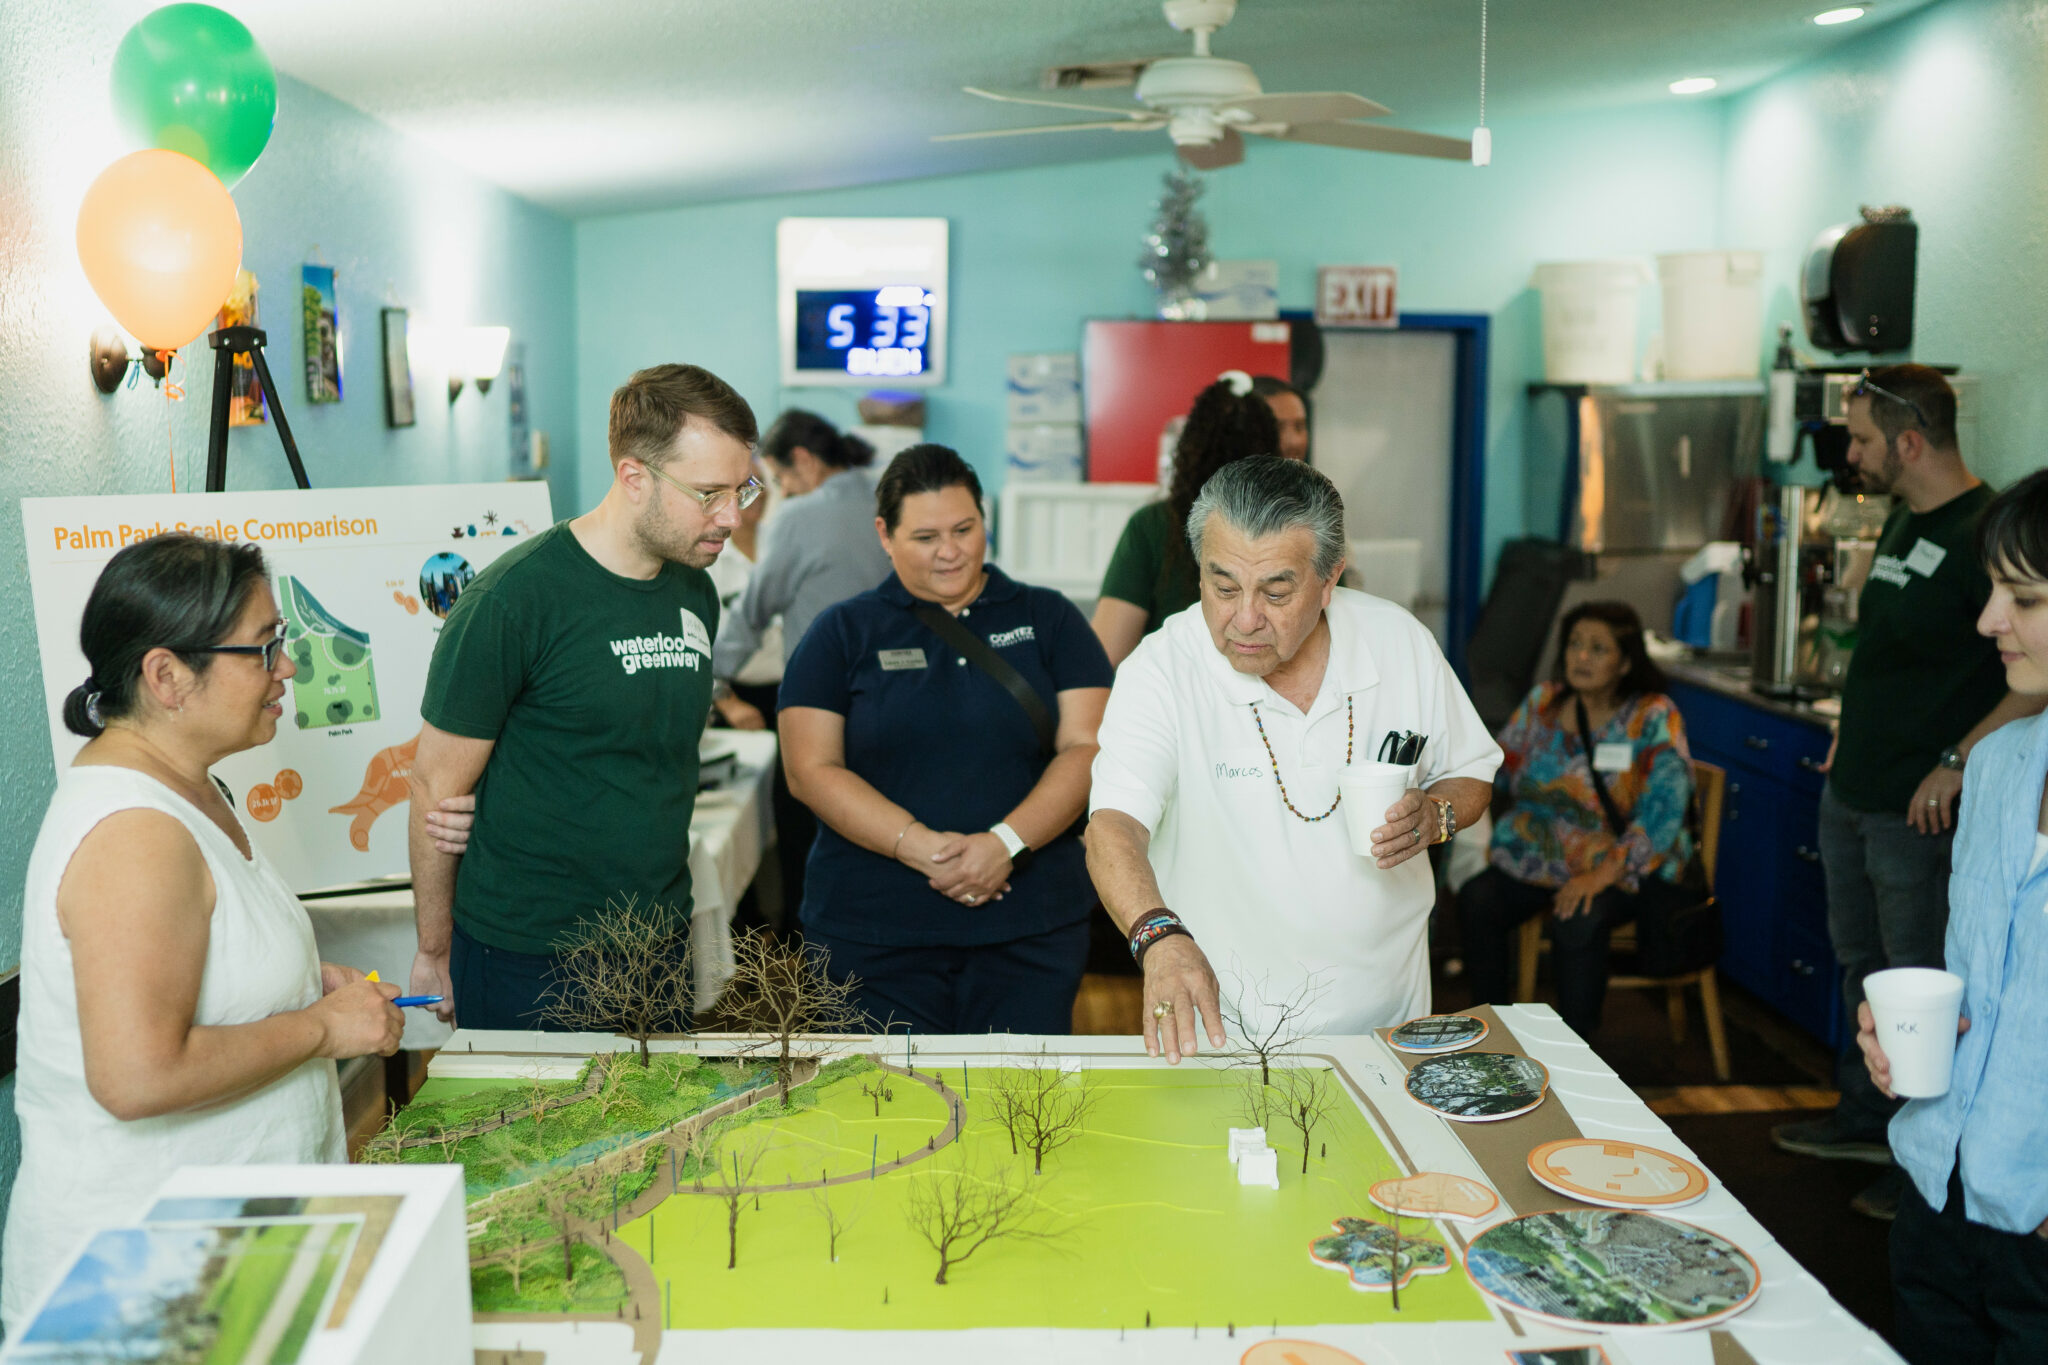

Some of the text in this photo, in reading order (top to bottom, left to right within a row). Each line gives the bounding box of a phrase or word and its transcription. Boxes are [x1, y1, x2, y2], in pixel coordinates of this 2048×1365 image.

[1325, 271, 1394, 318] EXIT
[53, 524, 114, 550] Palm
[118, 521, 169, 547] Park
[243, 514, 378, 544] Comparison
[609, 631, 685, 656] waterloo
[989, 625, 1034, 644] CORTEZ
[621, 651, 700, 675] greenway
[1215, 762, 1264, 779] Marcos
